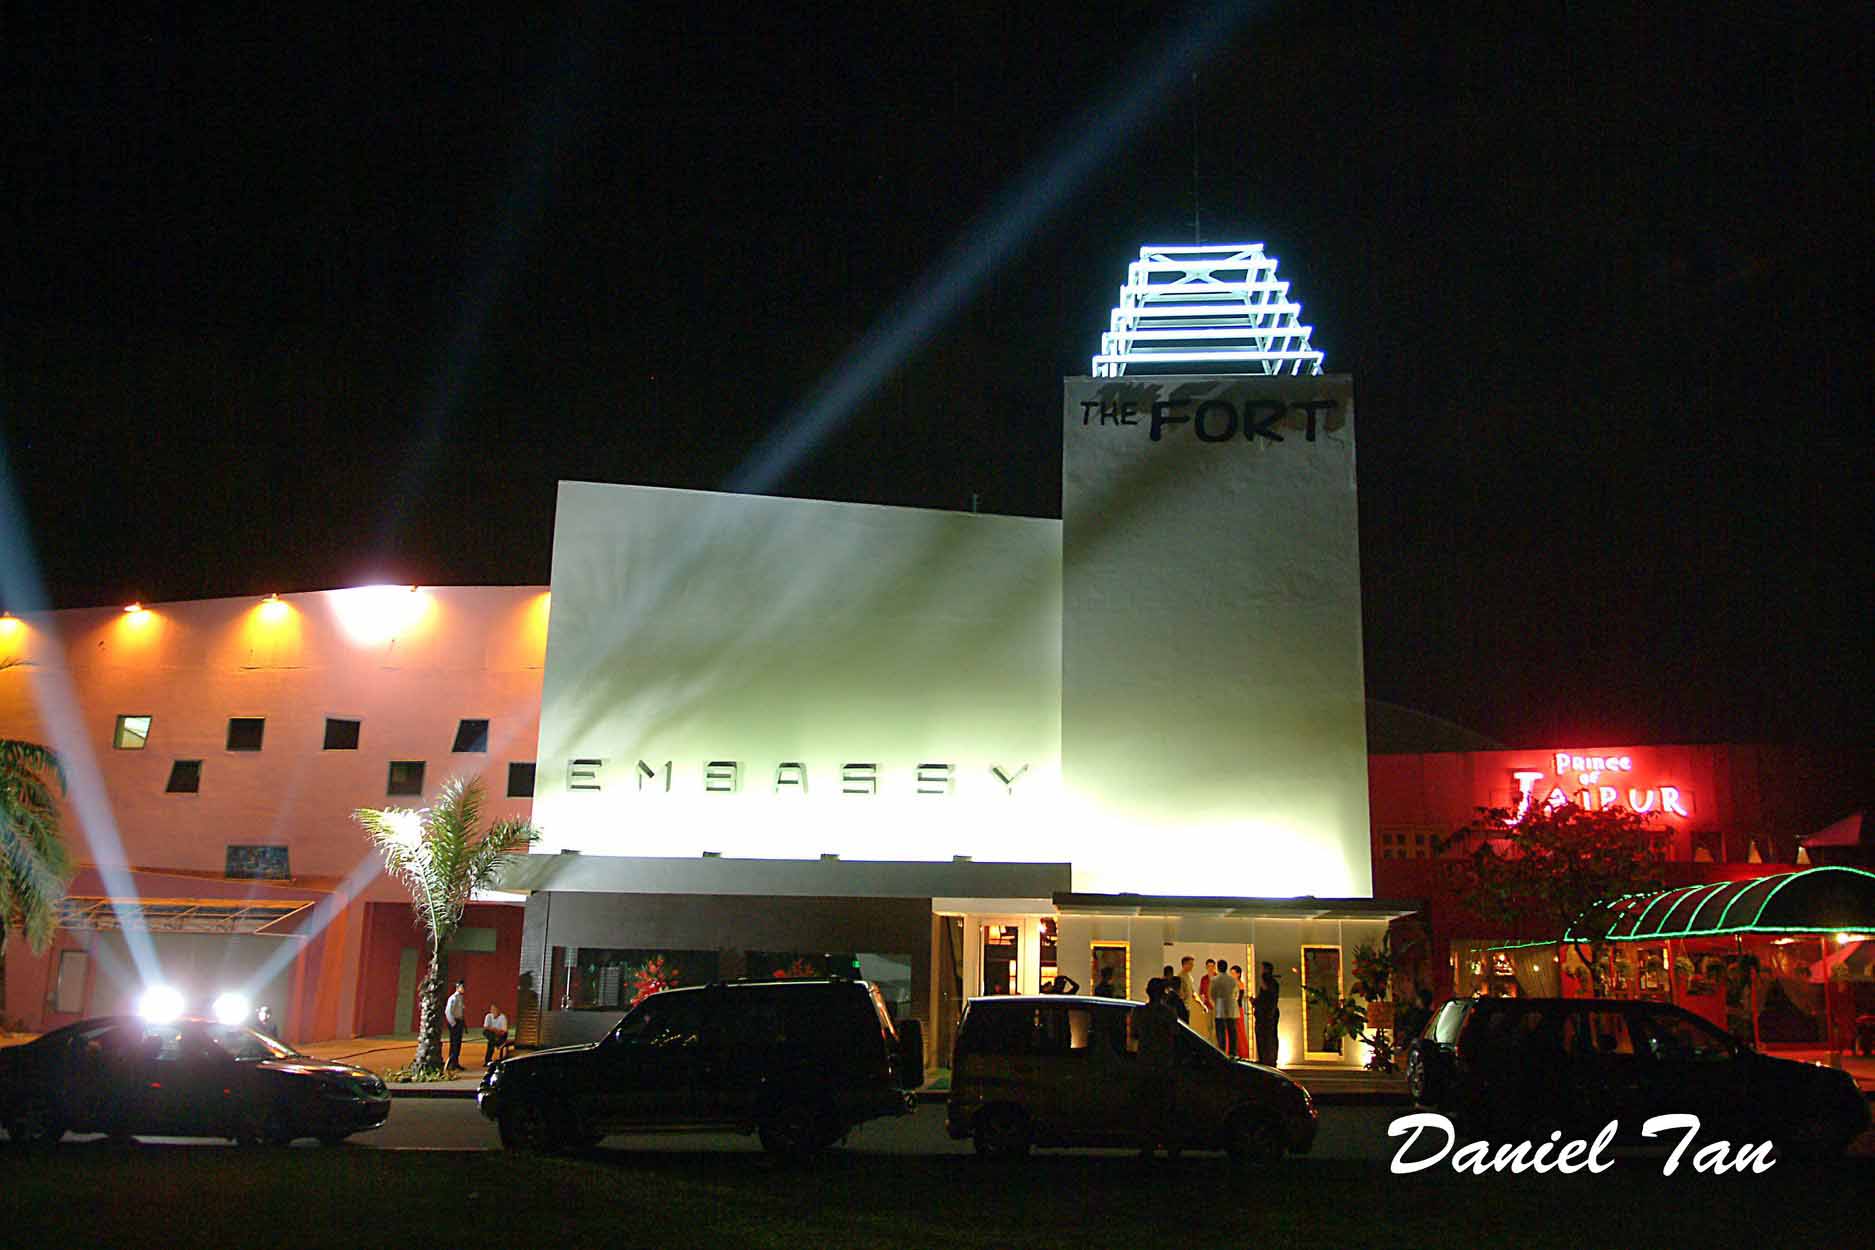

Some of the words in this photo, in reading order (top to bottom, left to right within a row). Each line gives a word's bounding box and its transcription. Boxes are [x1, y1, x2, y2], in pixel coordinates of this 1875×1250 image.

[1079, 401, 1138, 425] THE
[1150, 399, 1339, 442] FORT
[567, 758, 1029, 794] EMBASSY
